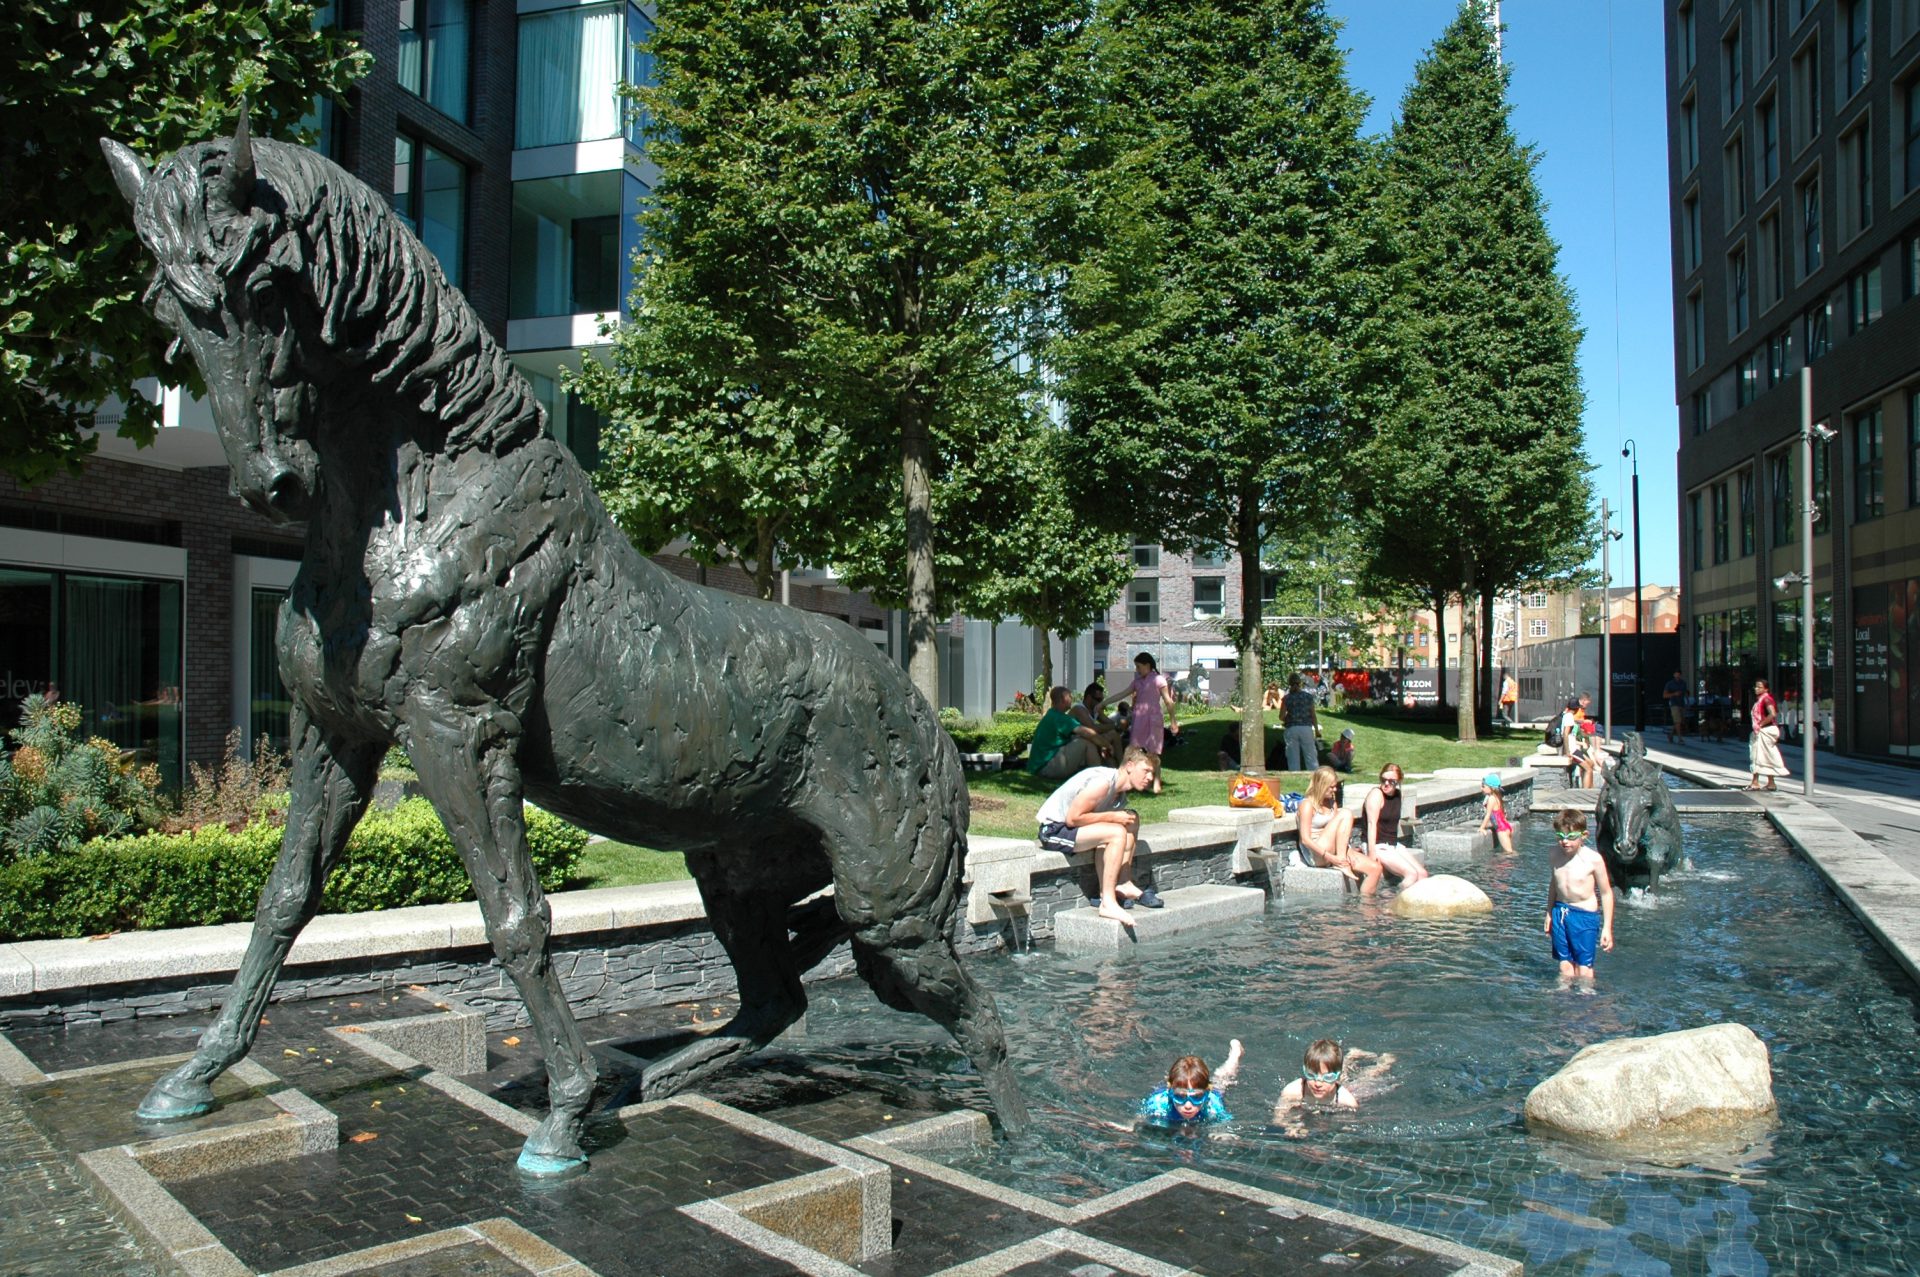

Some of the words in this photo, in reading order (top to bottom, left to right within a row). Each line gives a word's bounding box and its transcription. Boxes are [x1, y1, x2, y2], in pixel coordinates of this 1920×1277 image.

[1855, 627, 1870, 640] Local
[1612, 672, 1639, 681] Berkele
[1402, 680, 1432, 688] URZON
